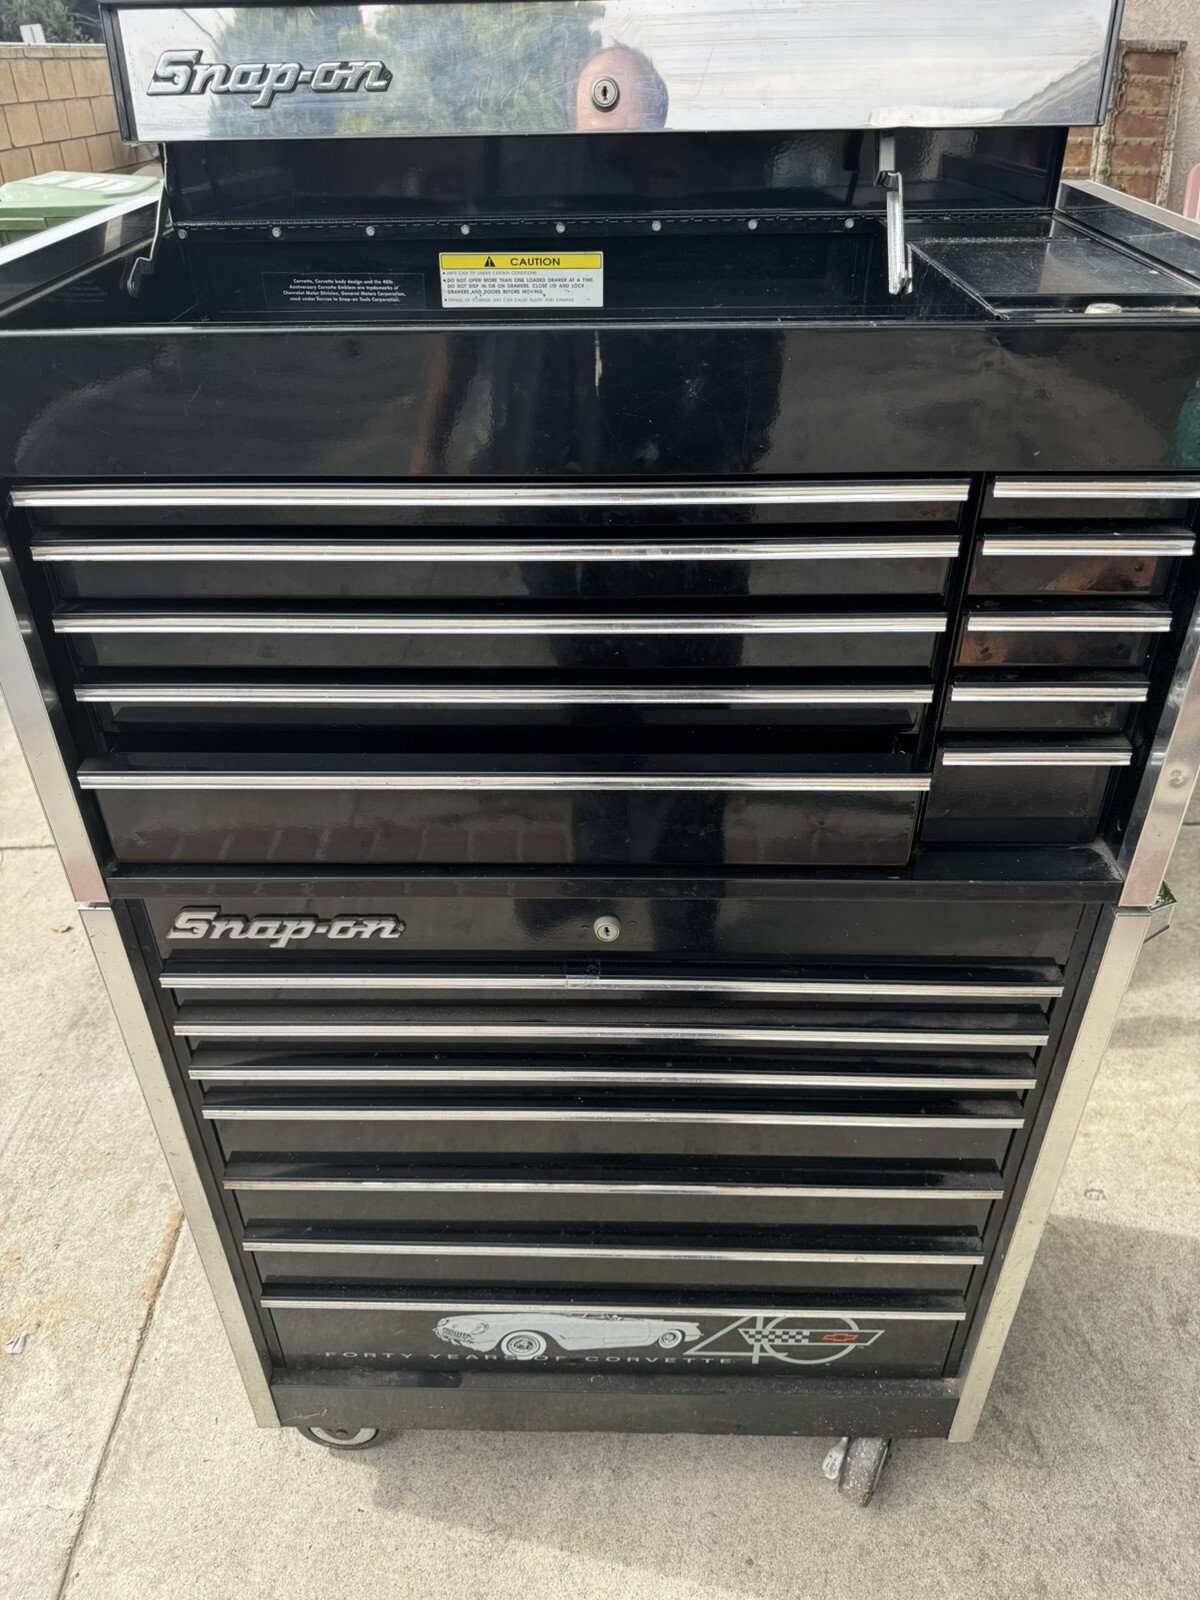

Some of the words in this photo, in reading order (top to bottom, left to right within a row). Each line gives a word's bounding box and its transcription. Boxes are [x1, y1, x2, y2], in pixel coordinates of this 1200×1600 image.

[147, 50, 392, 108] Snap-on
[510, 257, 561, 267] CAUTION
[166, 905, 405, 948] Snap-on
[324, 1351, 413, 1360] FORTY
[429, 1353, 517, 1361] YEARS
[584, 1356, 732, 1364] CORVETTE
